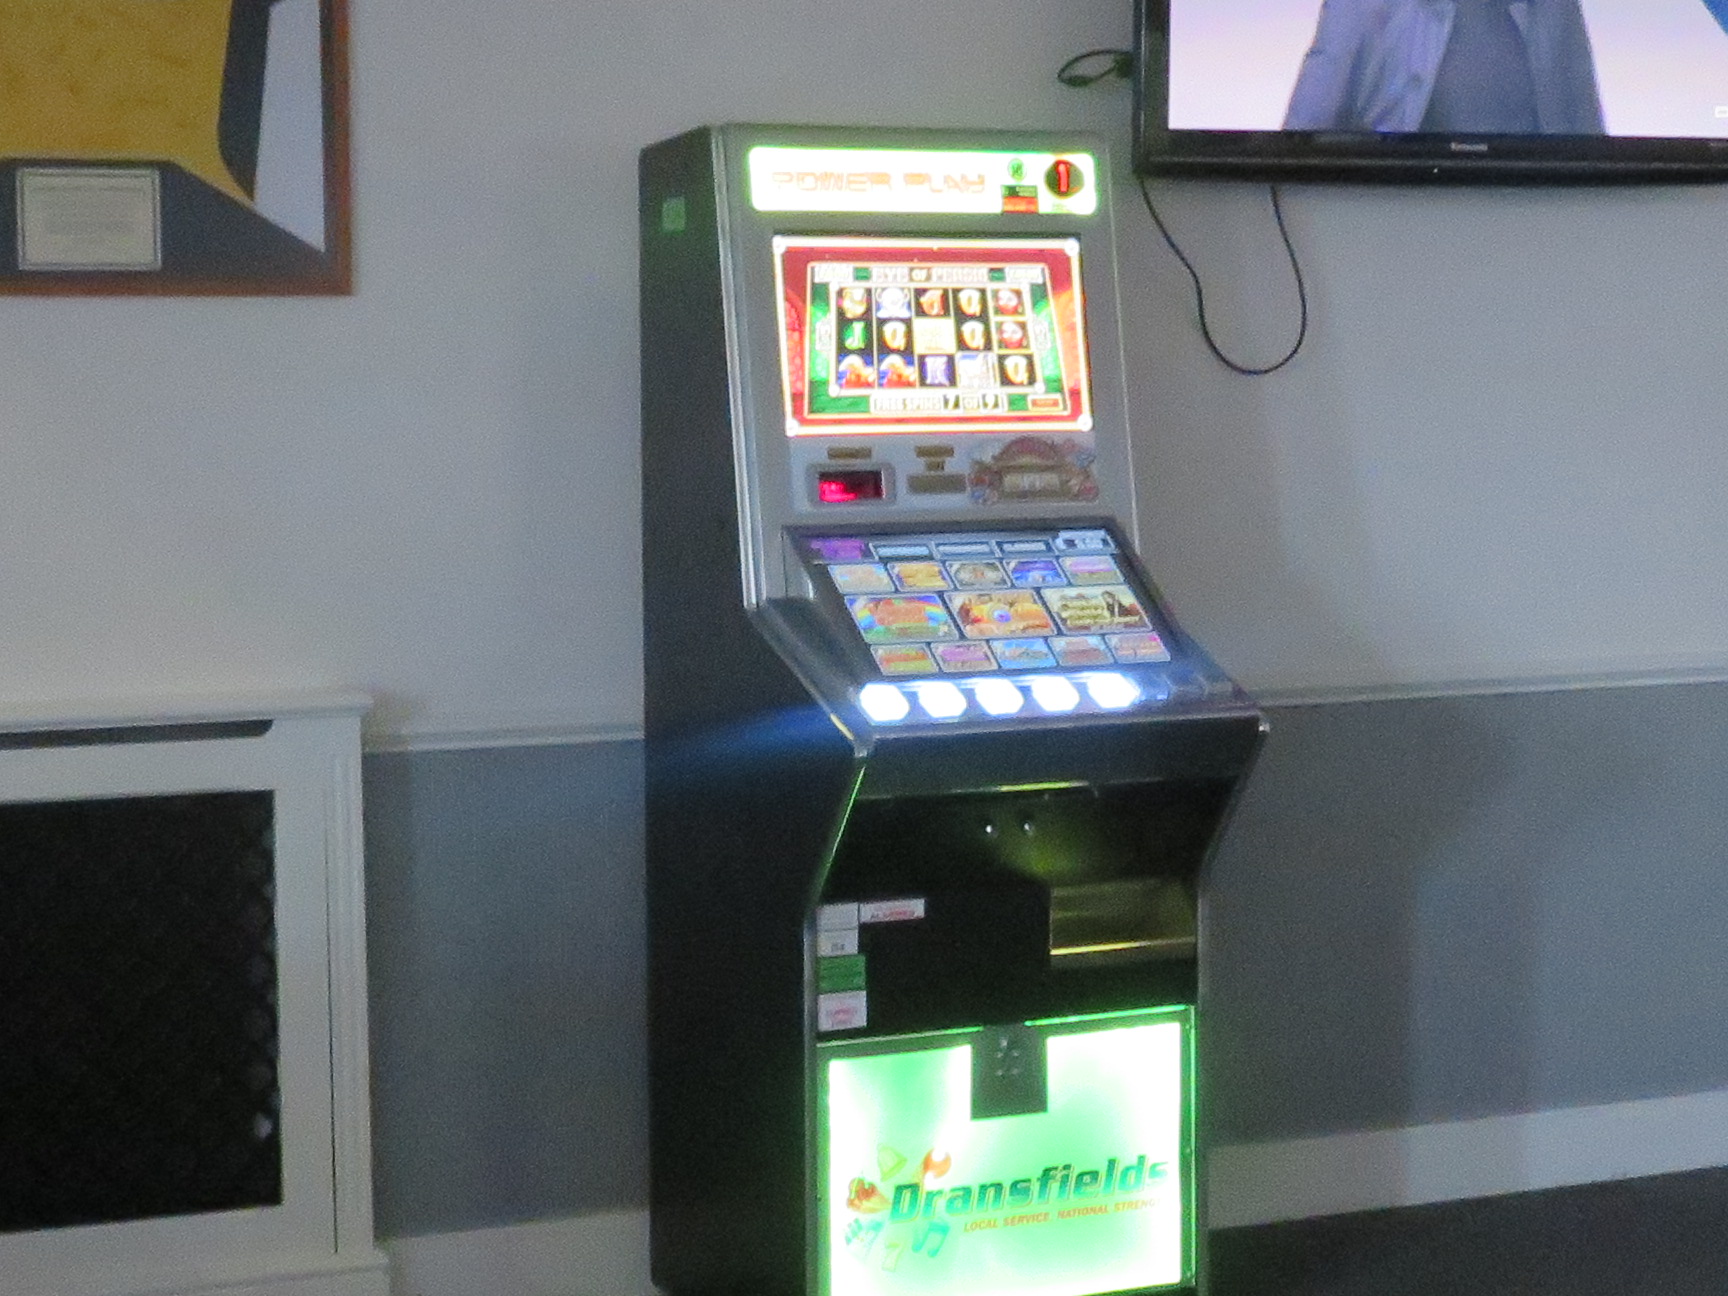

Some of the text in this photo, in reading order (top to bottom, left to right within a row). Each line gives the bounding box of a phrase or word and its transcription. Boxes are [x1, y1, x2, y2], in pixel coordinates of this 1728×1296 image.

[772, 171, 985, 194] POWER PLAY
[889, 1154, 1170, 1224] Dransfields
[963, 1219, 998, 1234] LOCAL
[1057, 1204, 1109, 1220] NATIONAL
